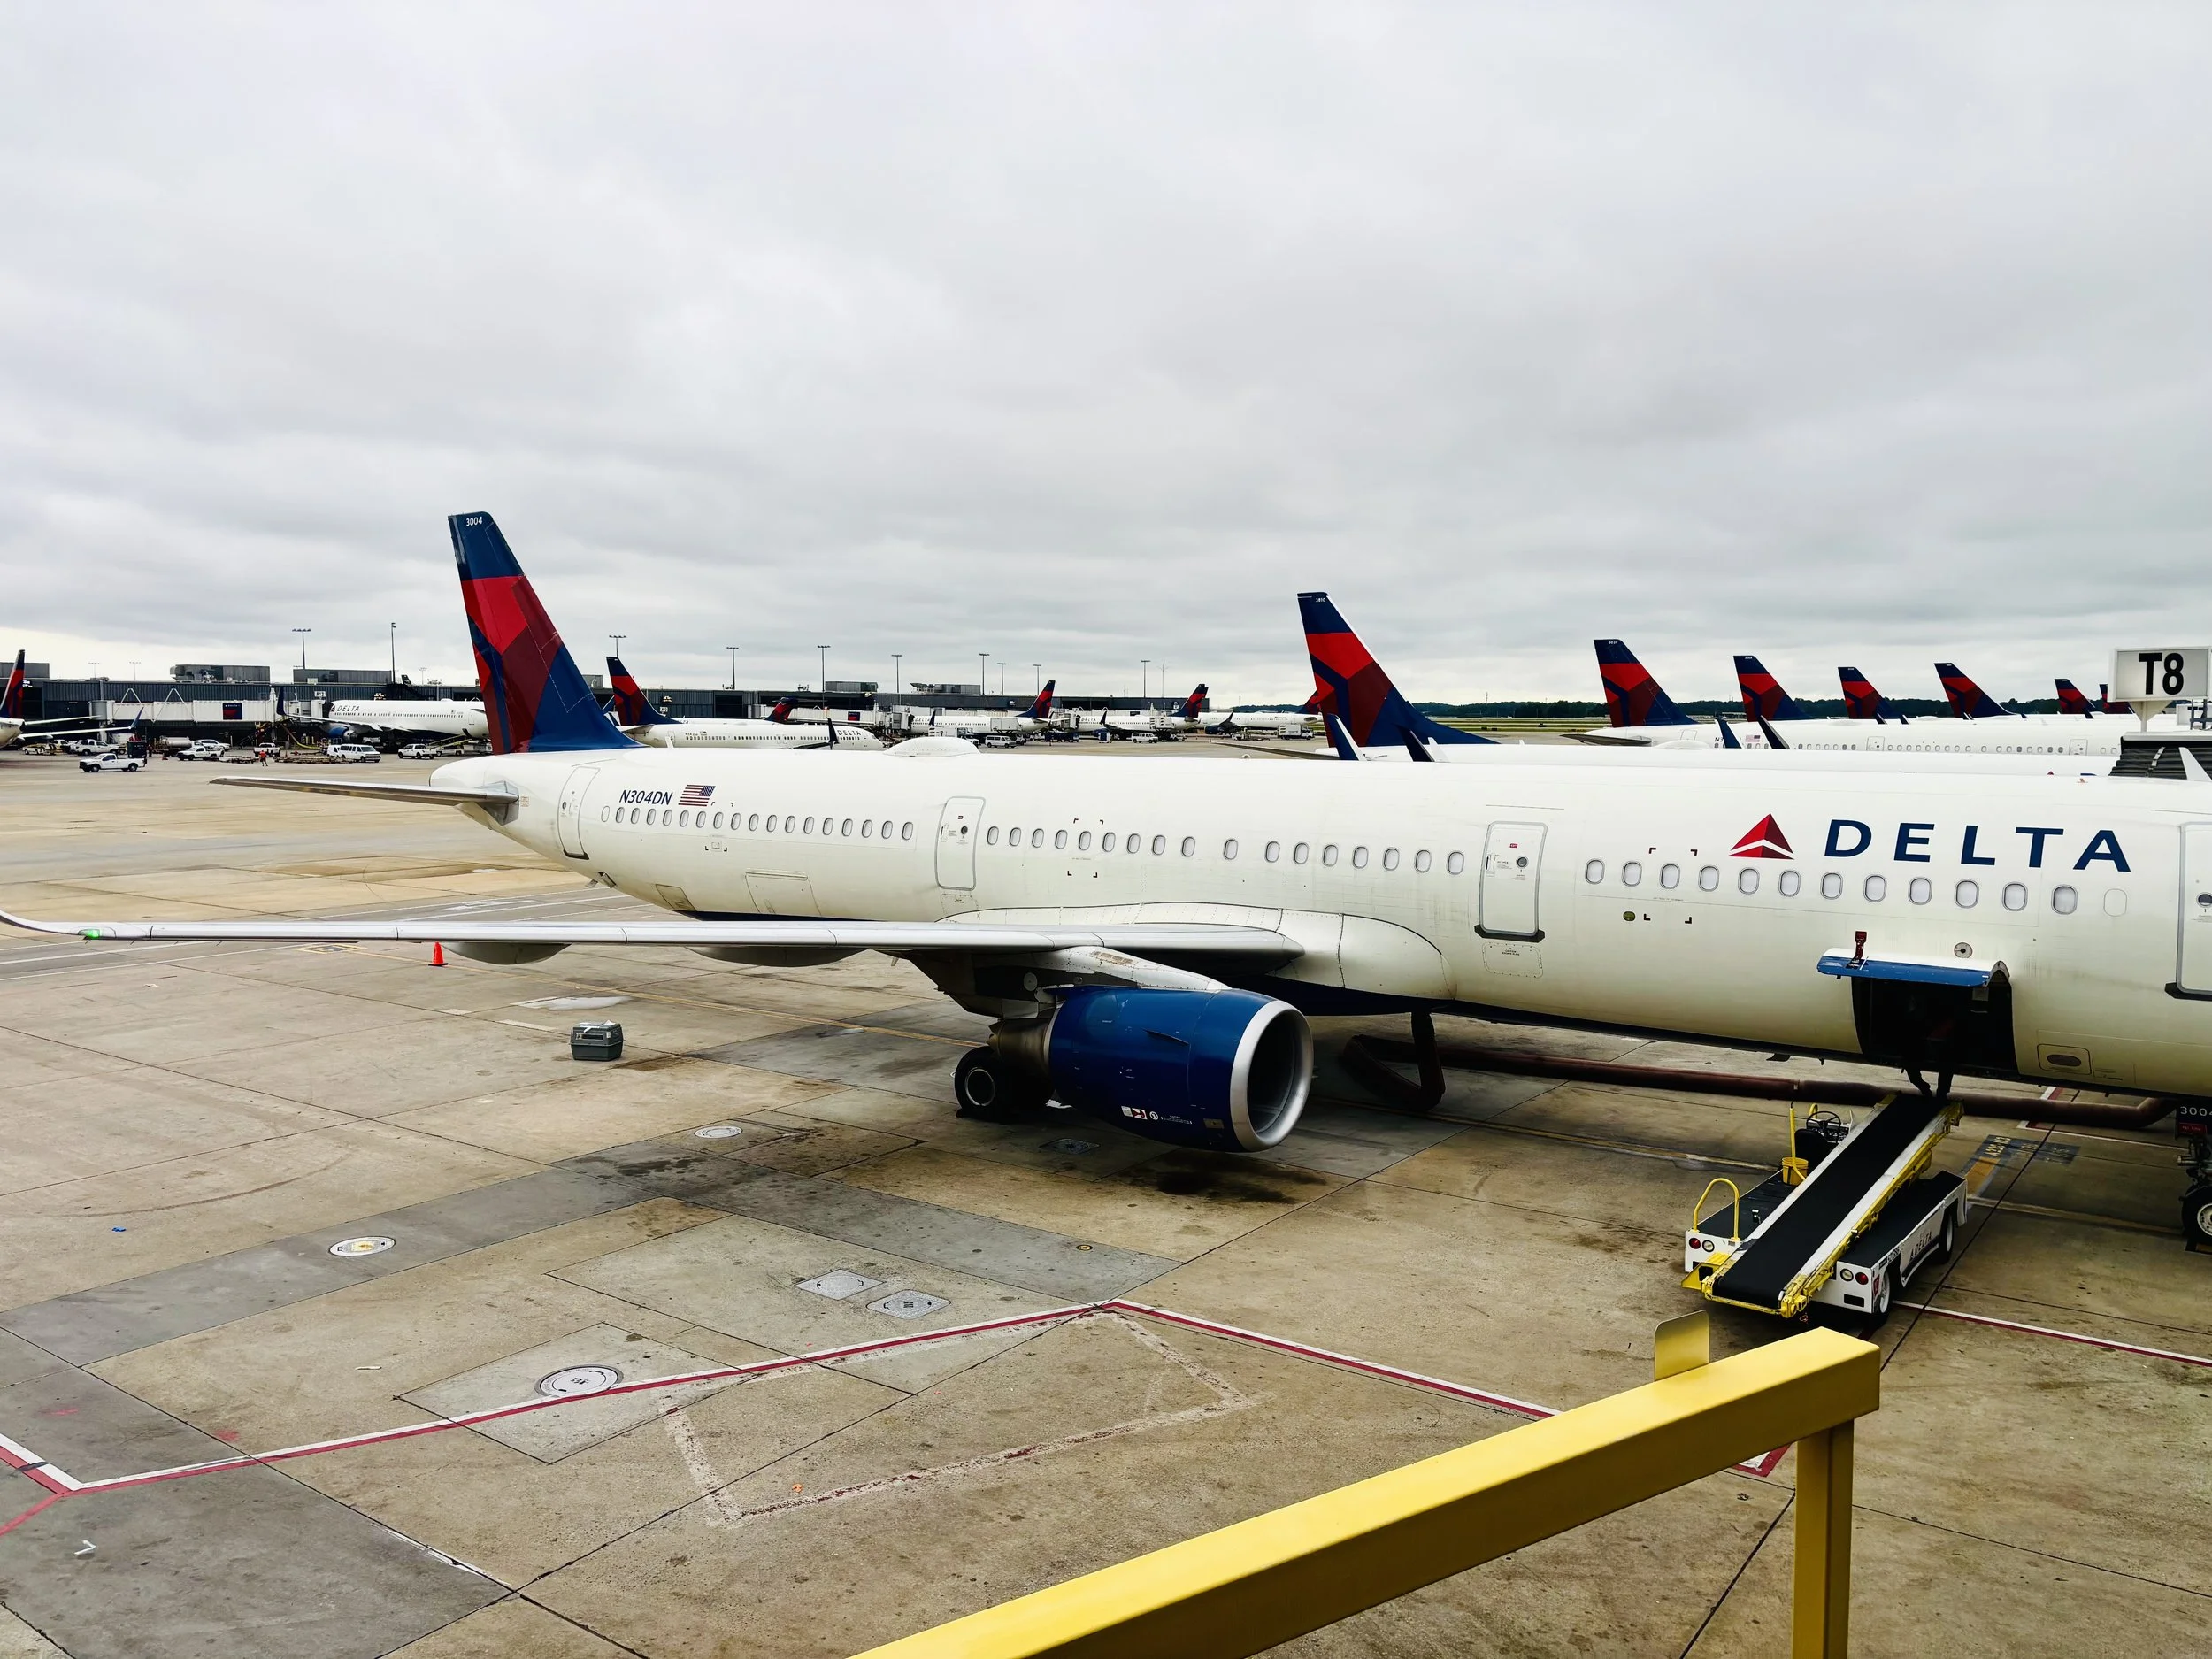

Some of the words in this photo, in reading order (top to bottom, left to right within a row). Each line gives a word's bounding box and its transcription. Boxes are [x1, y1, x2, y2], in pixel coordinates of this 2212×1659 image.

[466, 516, 483, 526] 3004
[2139, 652, 2184, 695] T8
[618, 789, 673, 805] N304DN
[1824, 819, 2131, 872] DELTA
